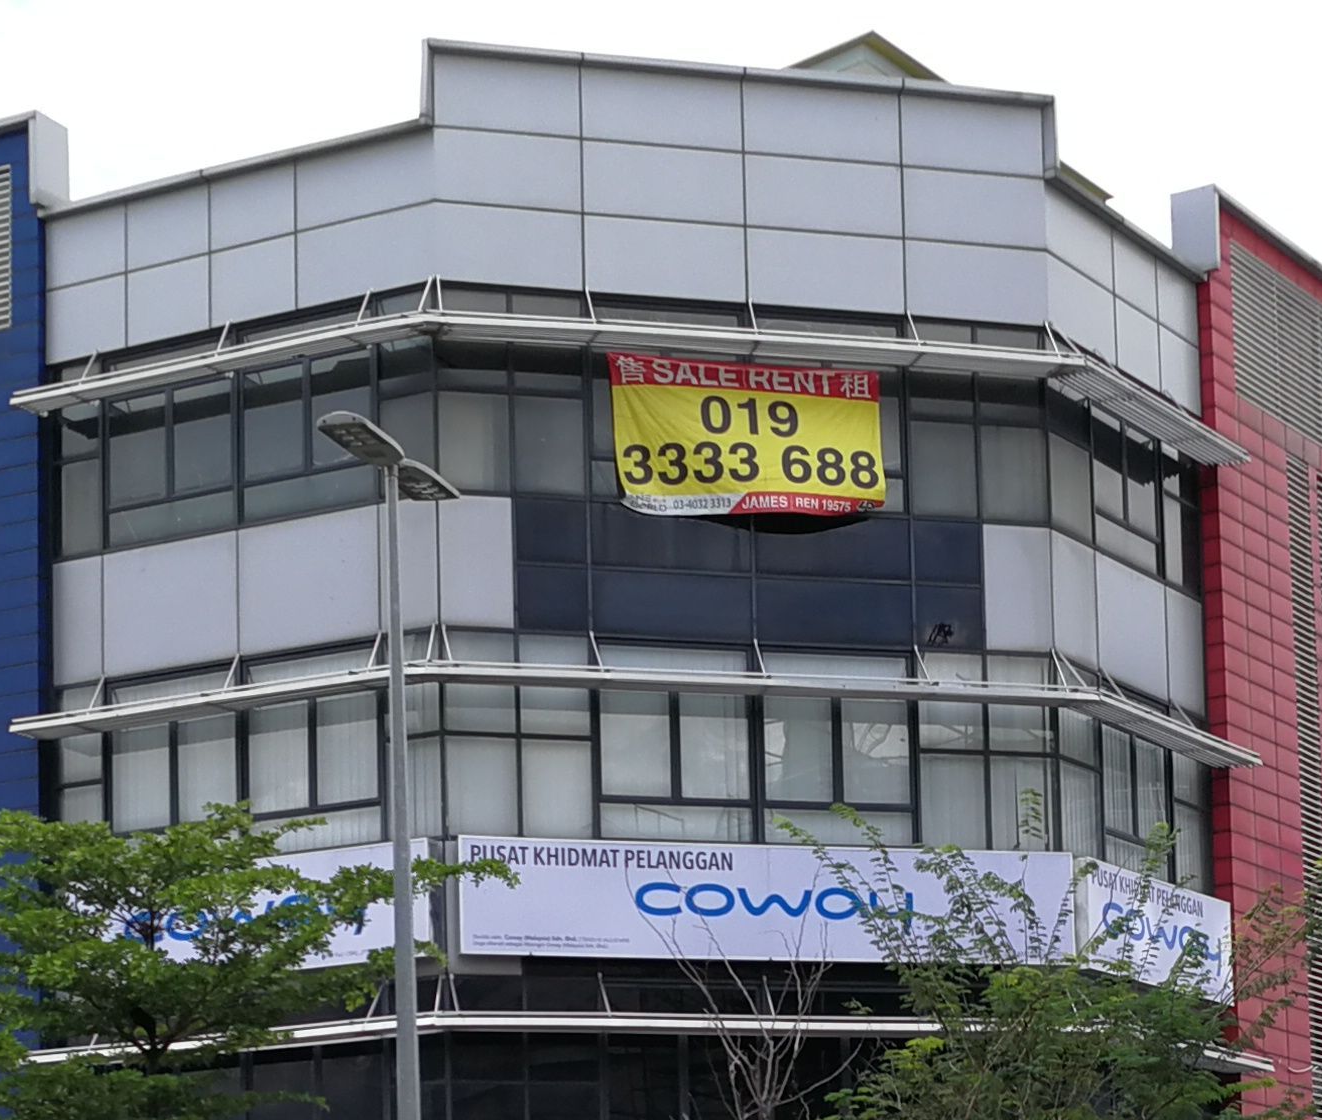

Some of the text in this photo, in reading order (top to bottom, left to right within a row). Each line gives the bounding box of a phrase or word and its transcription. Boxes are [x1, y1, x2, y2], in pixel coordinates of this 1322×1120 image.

[653, 360, 740, 388] SALE
[749, 368, 836, 395] RENT
[840, 374, 871, 399] 租
[700, 395, 799, 438] 019
[623, 441, 880, 490] 3333 688
[741, 495, 788, 509] JAMES
[795, 496, 819, 508] REN
[821, 498, 851, 512] 19575
[470, 844, 734, 872] PUSAT KHIDMAT PELANGGAN
[1091, 870, 1119, 892] PUSAT
